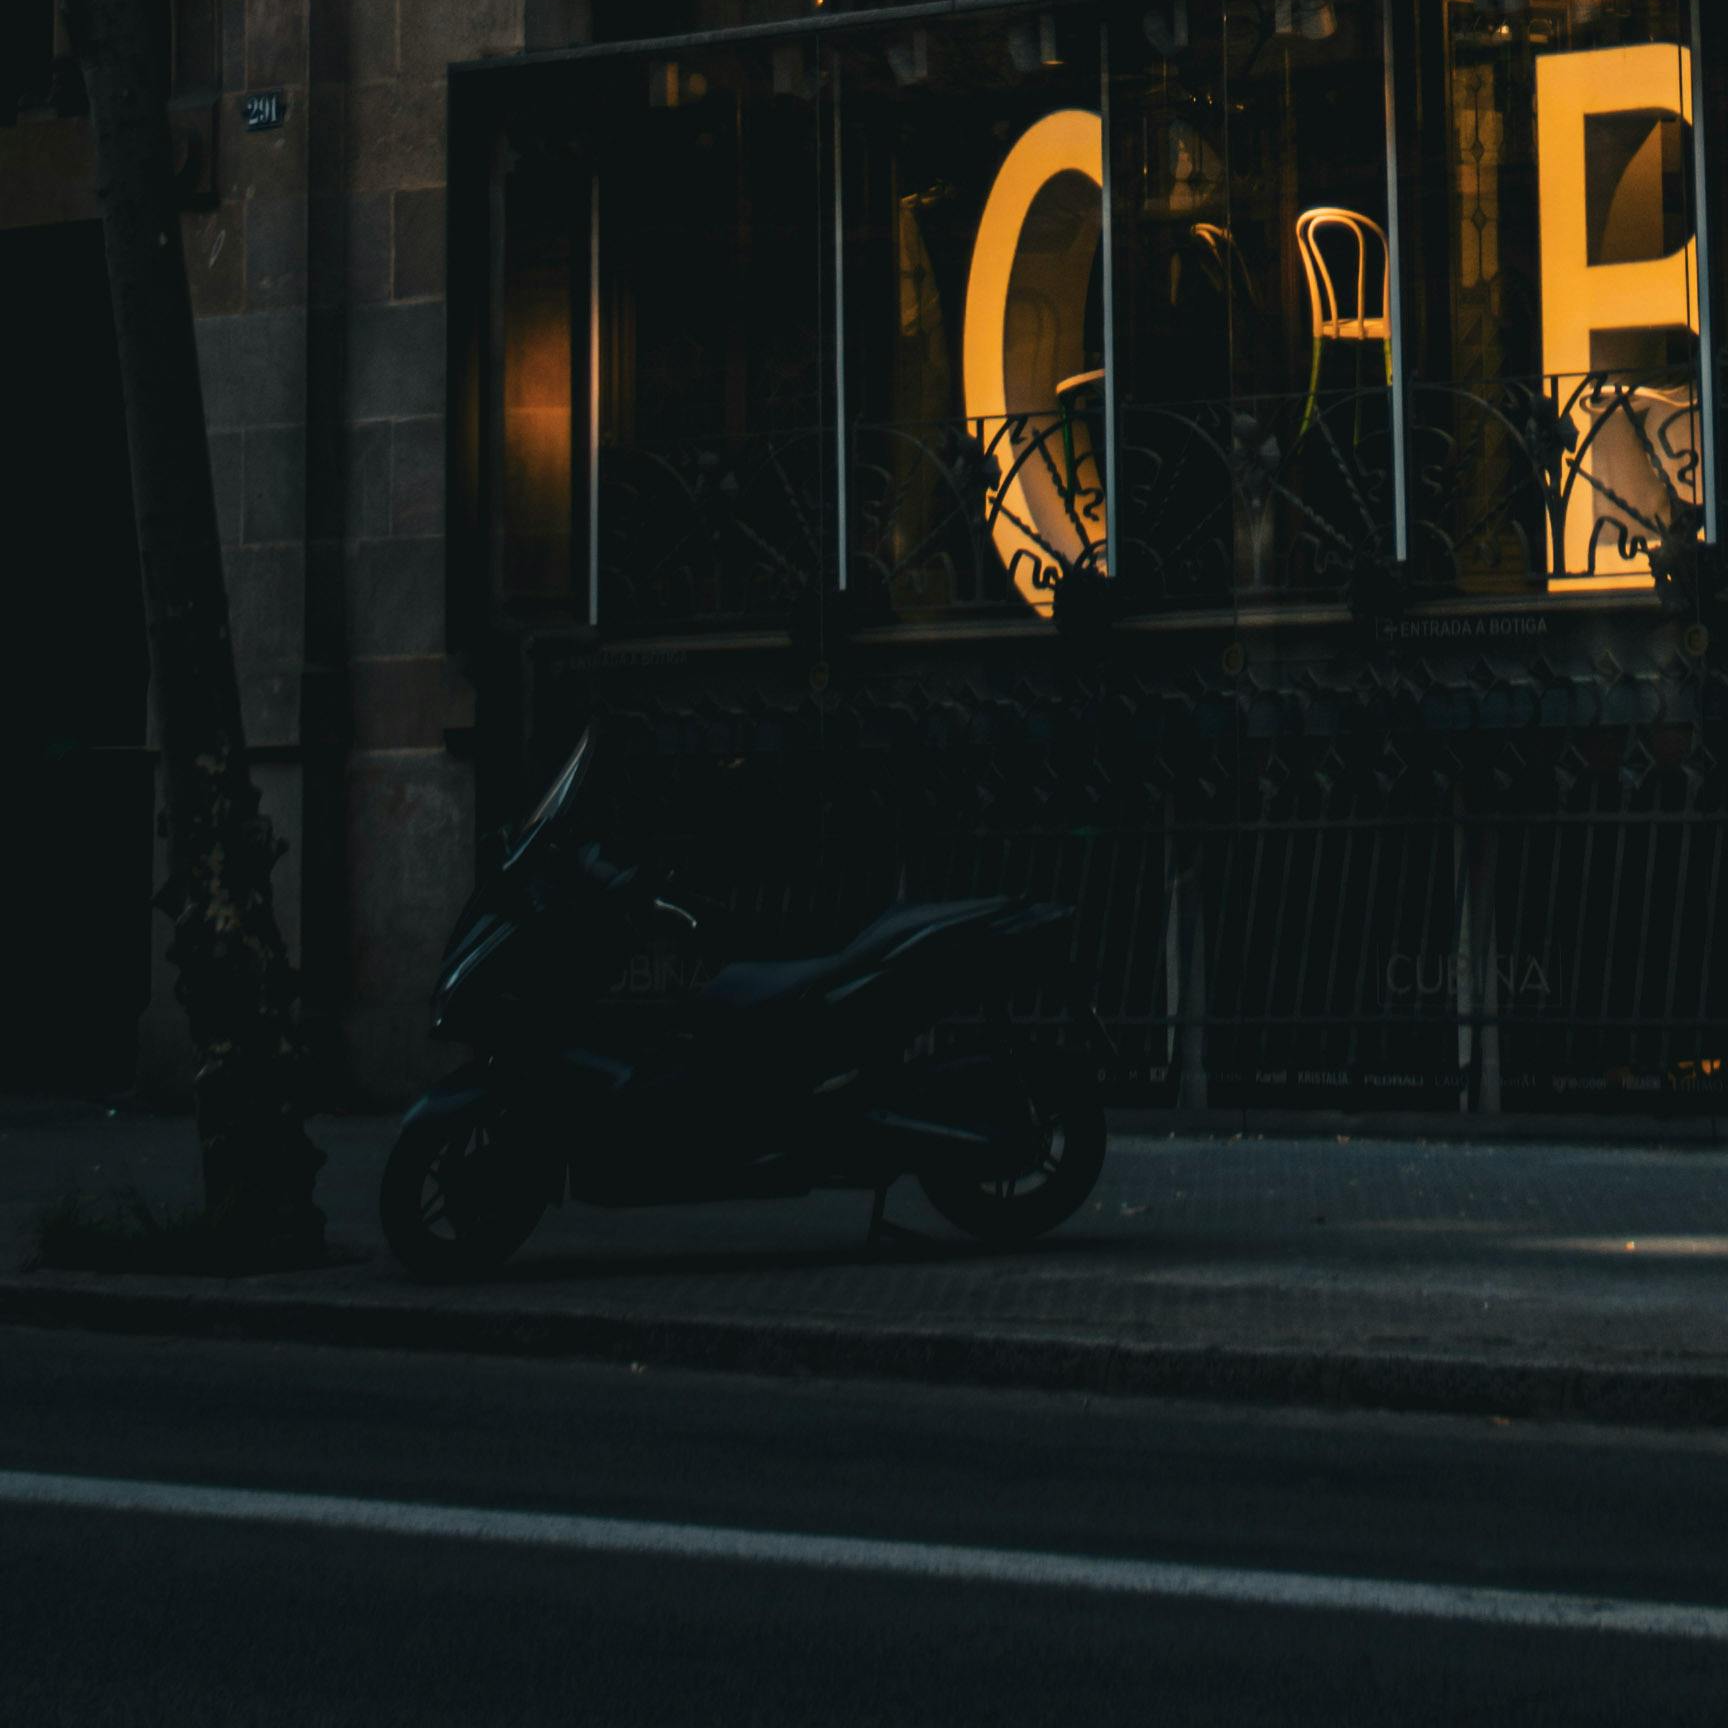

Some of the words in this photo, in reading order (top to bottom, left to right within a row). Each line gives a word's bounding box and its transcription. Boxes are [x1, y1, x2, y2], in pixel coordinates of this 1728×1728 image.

[246, 95, 278, 125] 291
[1400, 619, 1472, 638] ENTRADA
[1475, 618, 1487, 635] A
[1489, 616, 1548, 635] BOTIGA
[1386, 953, 1552, 995] CUBINA
